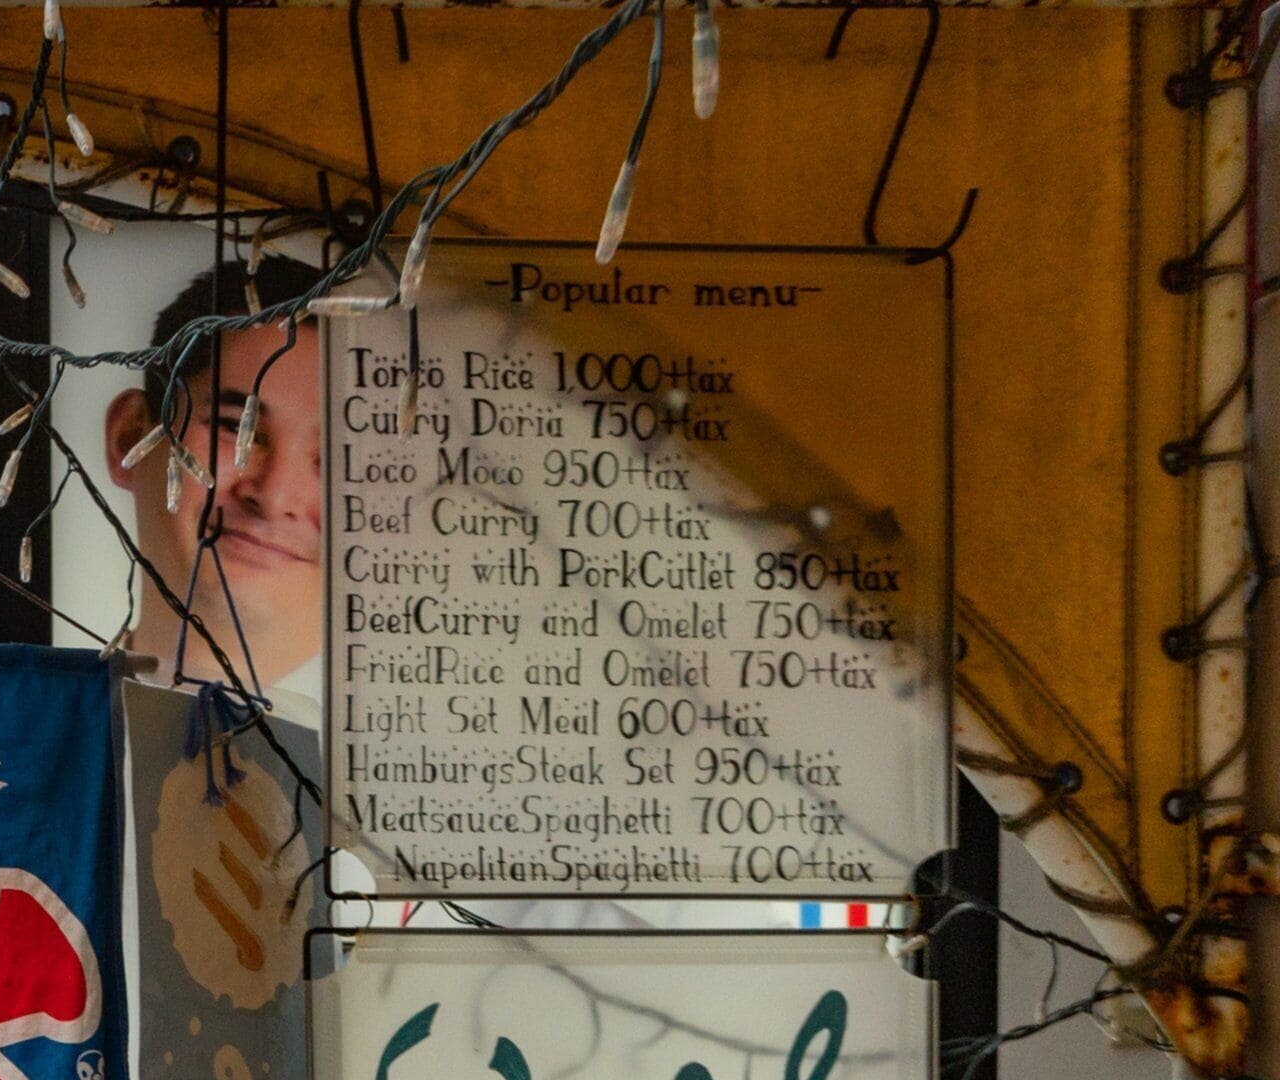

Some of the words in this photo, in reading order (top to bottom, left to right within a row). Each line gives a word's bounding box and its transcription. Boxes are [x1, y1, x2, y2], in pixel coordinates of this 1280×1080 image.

[464, 351, 534, 390] Rice
[556, 353, 735, 394] 1,000+tax
[472, 399, 562, 439] Doria
[582, 401, 729, 442] 750+tax
[344, 445, 416, 484] Loco
[441, 449, 523, 486] Moco
[543, 450, 689, 490] 950+tax
[345, 496, 410, 534] Beef
[432, 498, 538, 543] Curry
[559, 500, 710, 541] 700+tax
[344, 545, 449, 590] Curry
[474, 550, 538, 587] with
[754, 553, 900, 591] 850+tax
[543, 601, 599, 637] and
[620, 603, 726, 639] Omelet
[753, 603, 895, 640] 750+tax
[525, 649, 581, 685] and
[603, 651, 709, 687] Omelet
[731, 651, 876, 690] 750+tax
[344, 696, 427, 741] Light
[449, 697, 498, 733] Set
[521, 699, 599, 736] Meal
[618, 699, 769, 738] 600+tax
[626, 748, 674, 785] Set
[694, 749, 841, 787] 950+tax
[693, 797, 843, 836] 700+tax
[723, 847, 873, 885] 700+tax
